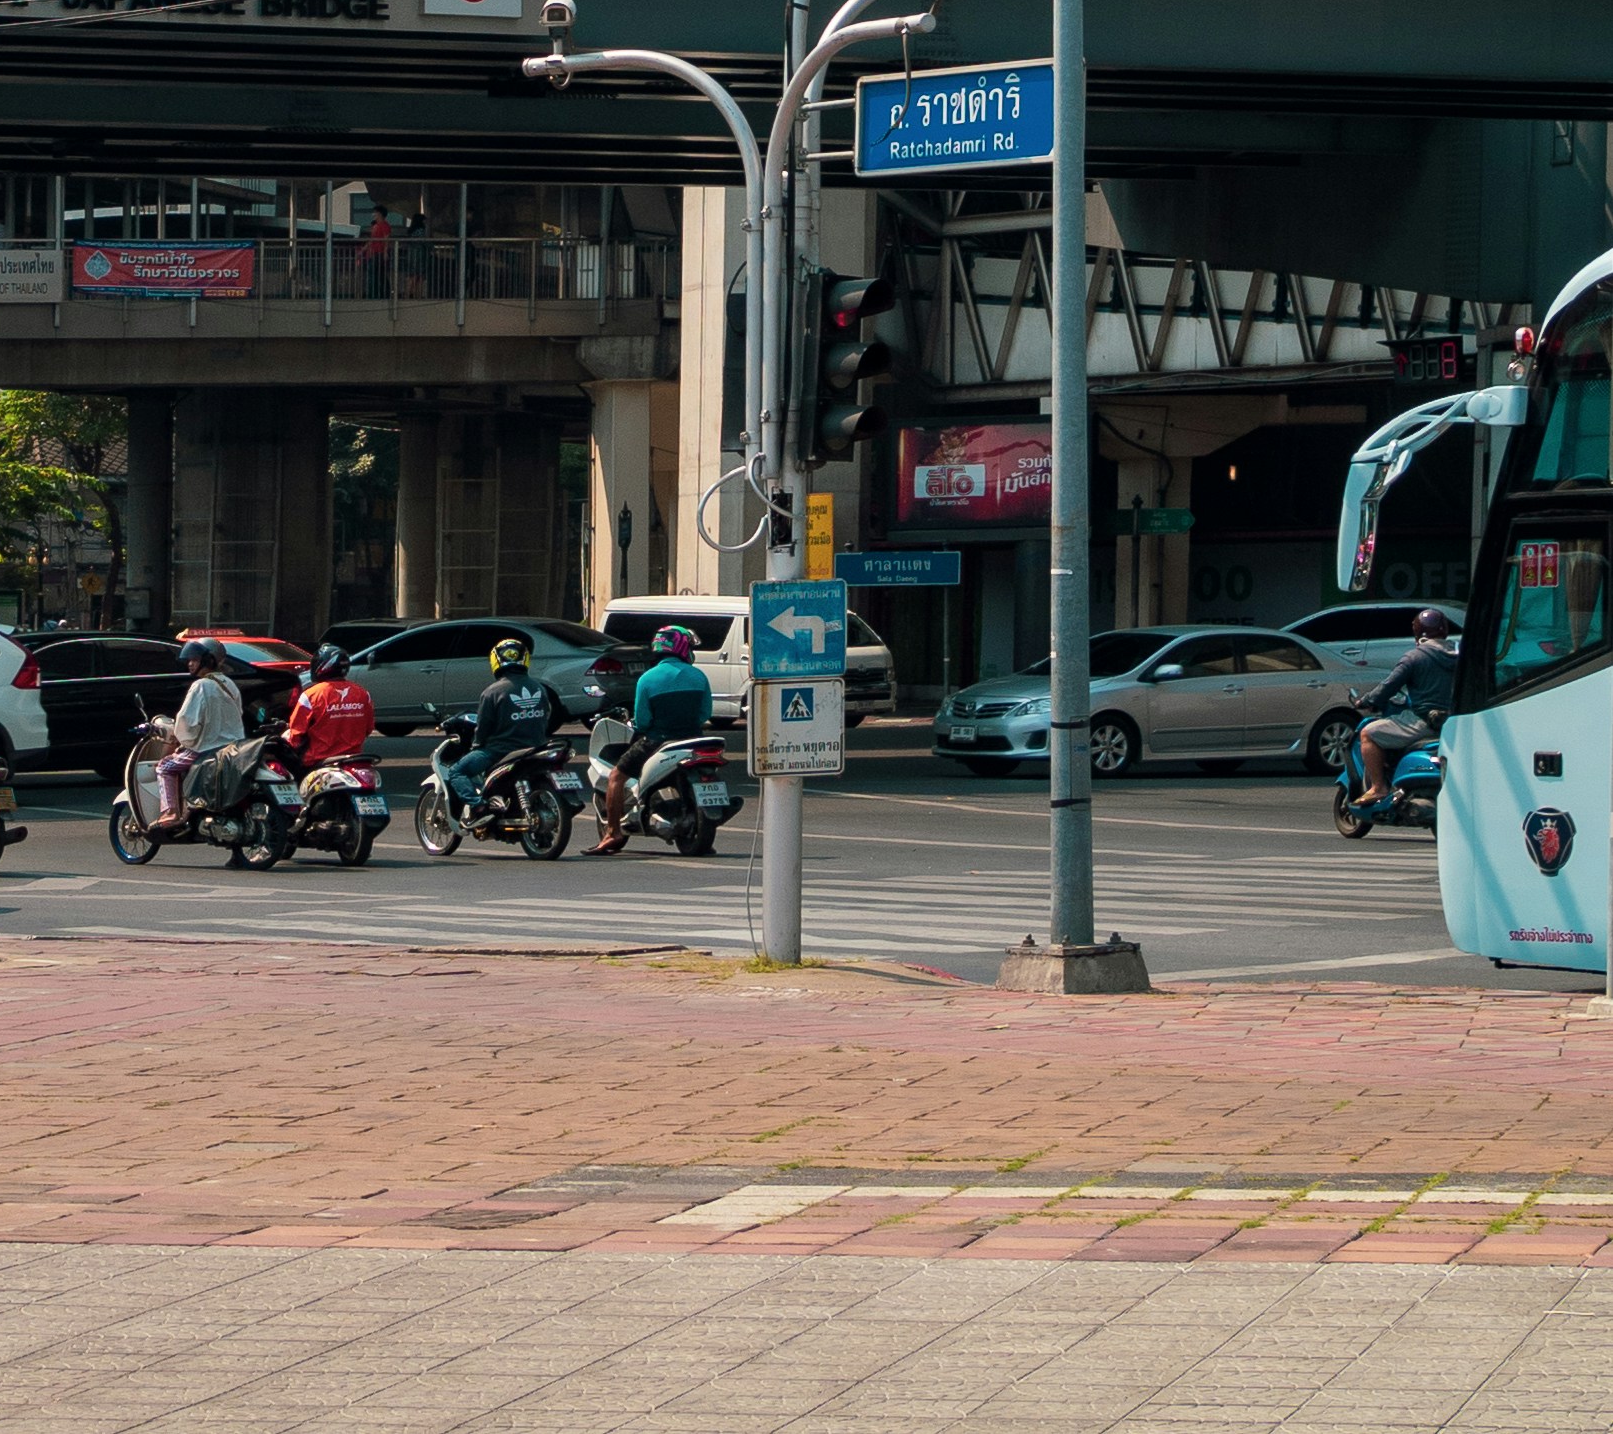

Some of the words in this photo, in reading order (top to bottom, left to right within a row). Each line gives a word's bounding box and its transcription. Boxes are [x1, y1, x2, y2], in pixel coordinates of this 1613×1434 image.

[916, 72, 1021, 127] ราชดำริ
[890, 135, 986, 160] Ratchadamri
[993, 132, 1020, 152] Rd.
[0, 283, 9, 295] OF
[11, 283, 48, 295] THAILAND
[864, 559, 930, 572] ศาลาแดง
[511, 709, 545, 721] adidas
[802, 741, 840, 756] หยุดรอ
